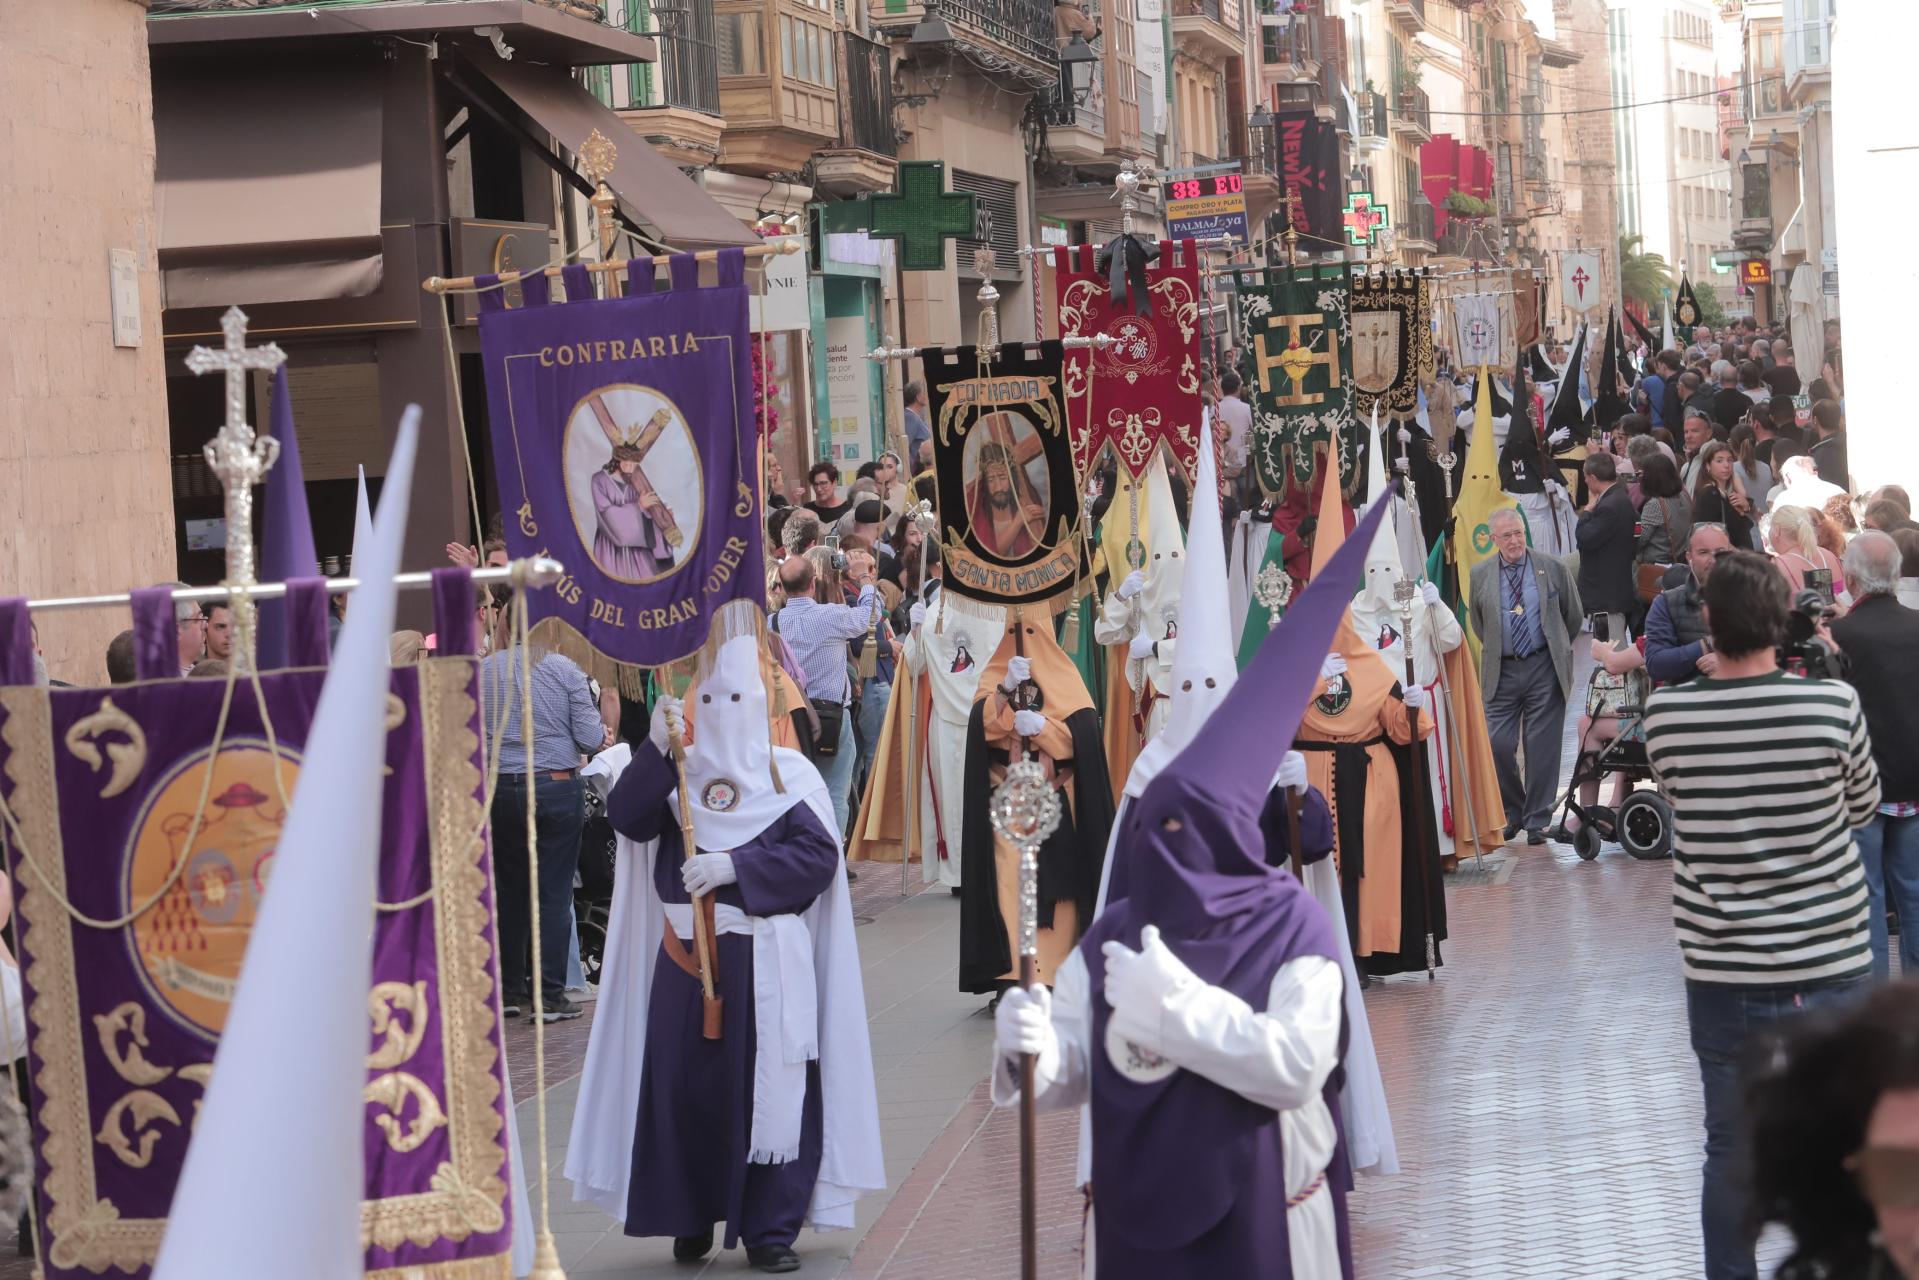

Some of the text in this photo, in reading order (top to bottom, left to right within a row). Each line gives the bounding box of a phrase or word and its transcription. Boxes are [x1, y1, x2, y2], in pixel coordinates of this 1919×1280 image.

[1173, 175, 1242, 200] 38 EU
[1169, 203, 1199, 212] COMPRO
[1223, 199, 1243, 207] PLATA
[540, 332, 700, 367] CONFRARIA
[826, 344, 848, 354] salud
[955, 552, 1077, 592] SANTA MONICA
[590, 598, 625, 628] DEL
[638, 597, 699, 630] GRAN
